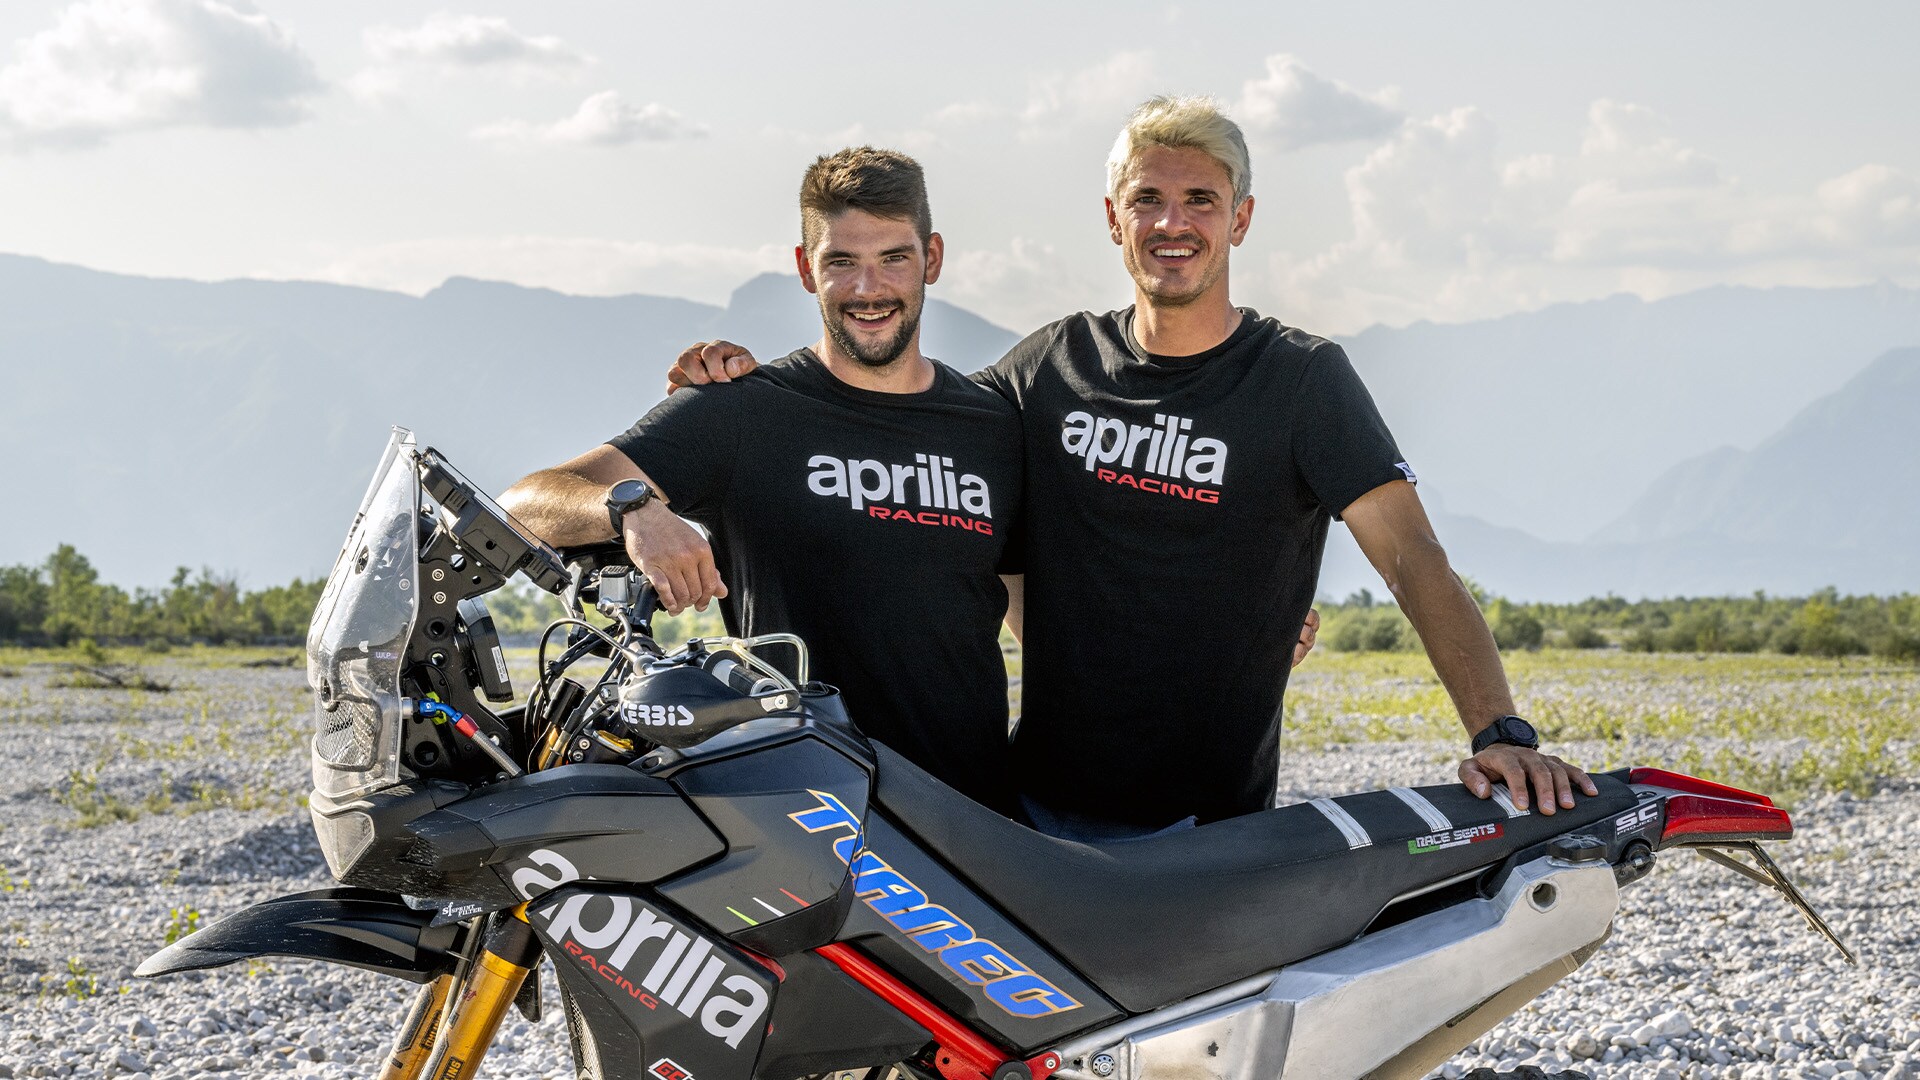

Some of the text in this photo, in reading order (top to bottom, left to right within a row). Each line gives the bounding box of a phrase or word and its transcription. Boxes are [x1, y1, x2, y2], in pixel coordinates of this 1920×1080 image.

[1062, 410, 1228, 485] aprilia
[807, 453, 993, 519] aprilia
[1097, 468, 1220, 504] RACING
[869, 505, 993, 536] RACING
[1415, 823, 1497, 848] RACE SEATS
[1615, 803, 1658, 832] SC
[1617, 815, 1658, 836] PROJECT
[458, 906, 483, 918] FILTER
[787, 788, 1085, 1019] TUAREG
[511, 848, 770, 1051] aprilia
[564, 940, 659, 1011] RACING
